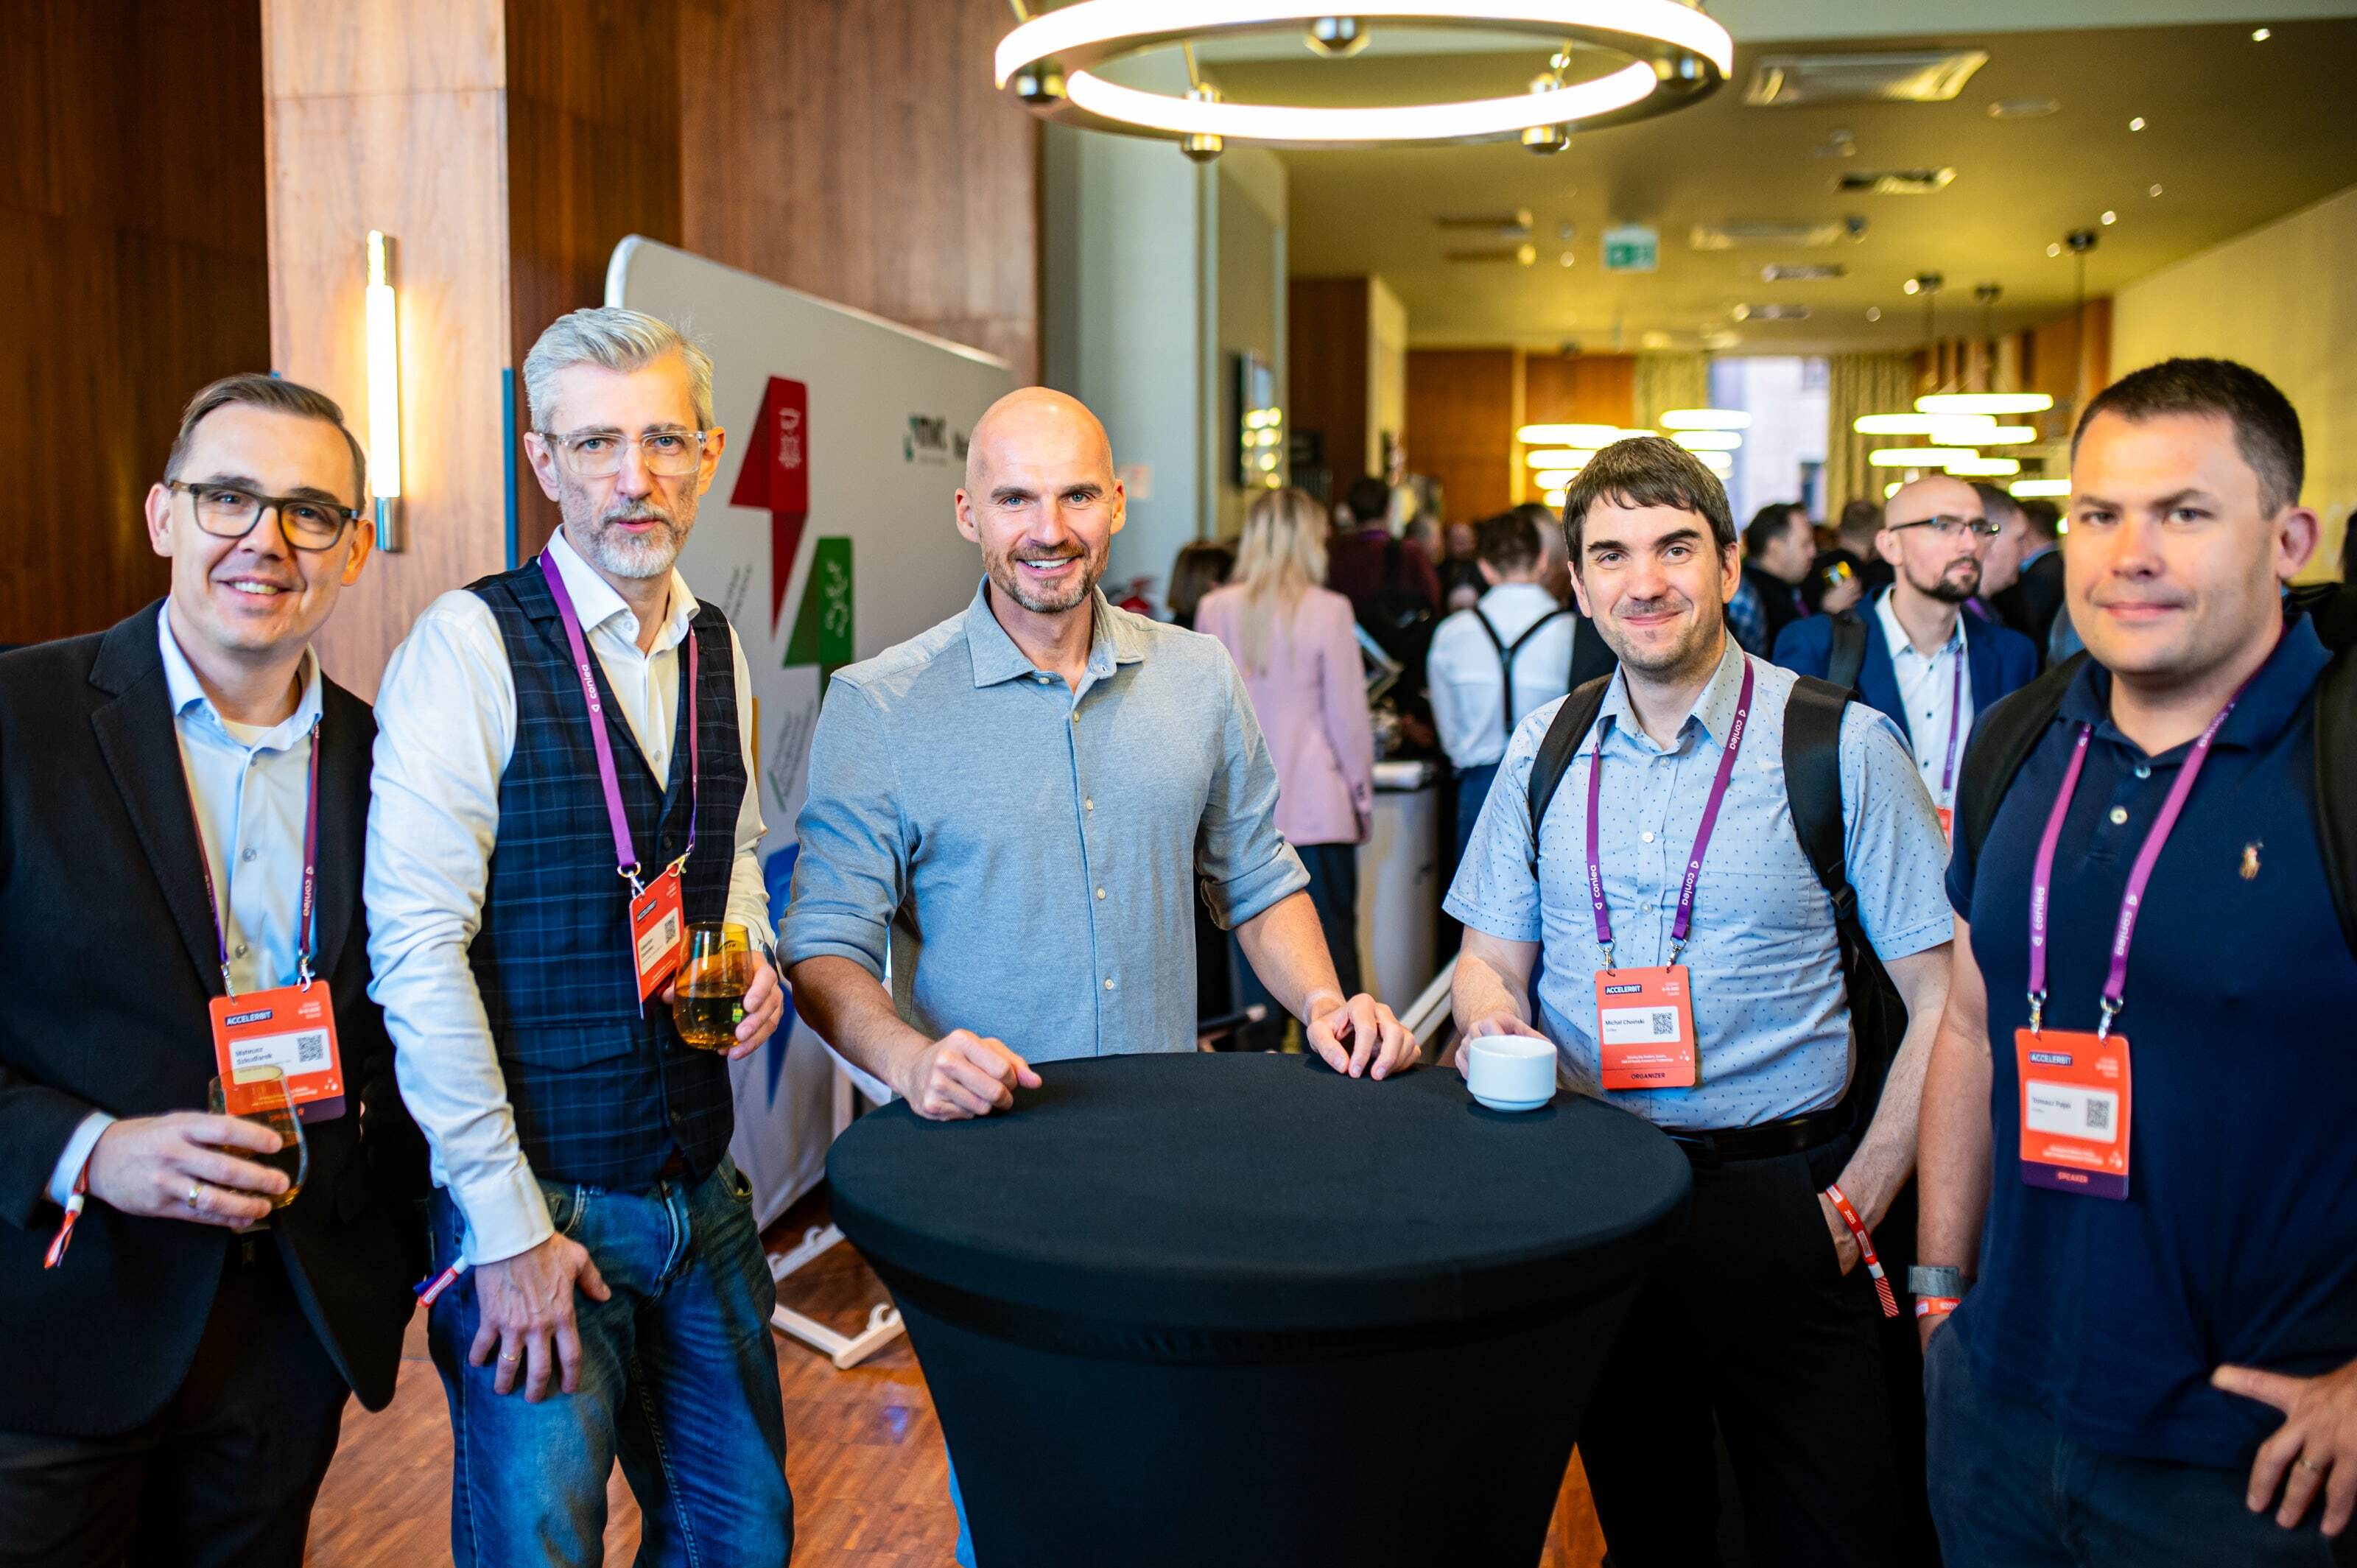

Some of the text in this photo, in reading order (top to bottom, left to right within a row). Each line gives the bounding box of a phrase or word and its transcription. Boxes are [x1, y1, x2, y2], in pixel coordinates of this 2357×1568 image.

[581, 664, 597, 699] conlea
[1729, 720, 1743, 750] conlea
[1590, 865, 1601, 898] conlea
[1682, 873, 1695, 907] conlea
[1606, 985, 1641, 994] ACCELERBIT
[226, 1010, 272, 1027] ACCELERBIT
[2031, 1053, 2072, 1066] ACCELERBIT
[2056, 1172, 2088, 1184] SPEAKER
